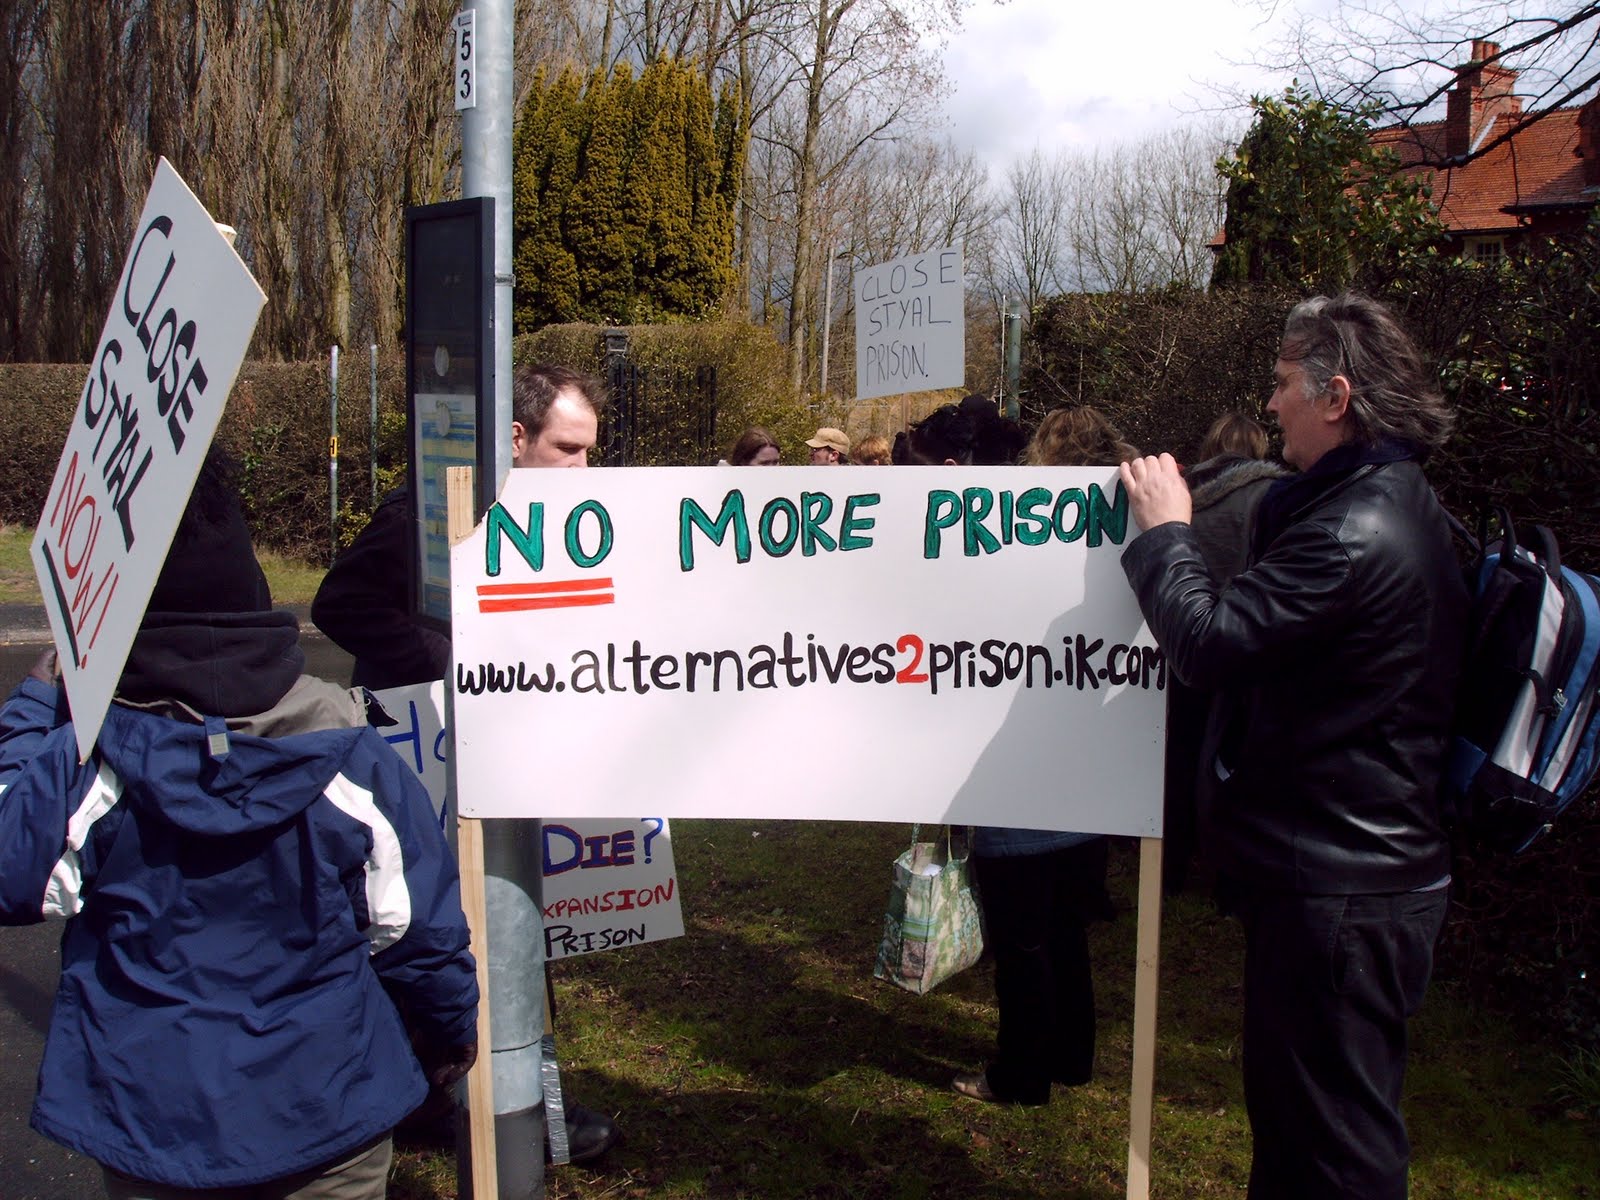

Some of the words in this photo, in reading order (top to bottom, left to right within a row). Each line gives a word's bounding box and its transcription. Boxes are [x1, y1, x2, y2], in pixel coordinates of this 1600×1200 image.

[862, 252, 957, 302] CLOSE
[124, 215, 208, 456] CLOSE
[869, 296, 952, 336] STYAL
[866, 340, 929, 386] PRISON.
[85, 339, 153, 553] STYAL
[50, 450, 119, 669] NOW!
[486, 499, 614, 577] NO
[679, 488, 881, 572] MORE
[924, 483, 1129, 559] PRISON
[457, 631, 1167, 695] www.alternatives2prison.ik.com
[542, 817, 663, 877] DIE?
[543, 877, 674, 919] XPANSION
[544, 923, 646, 958] PRISON
